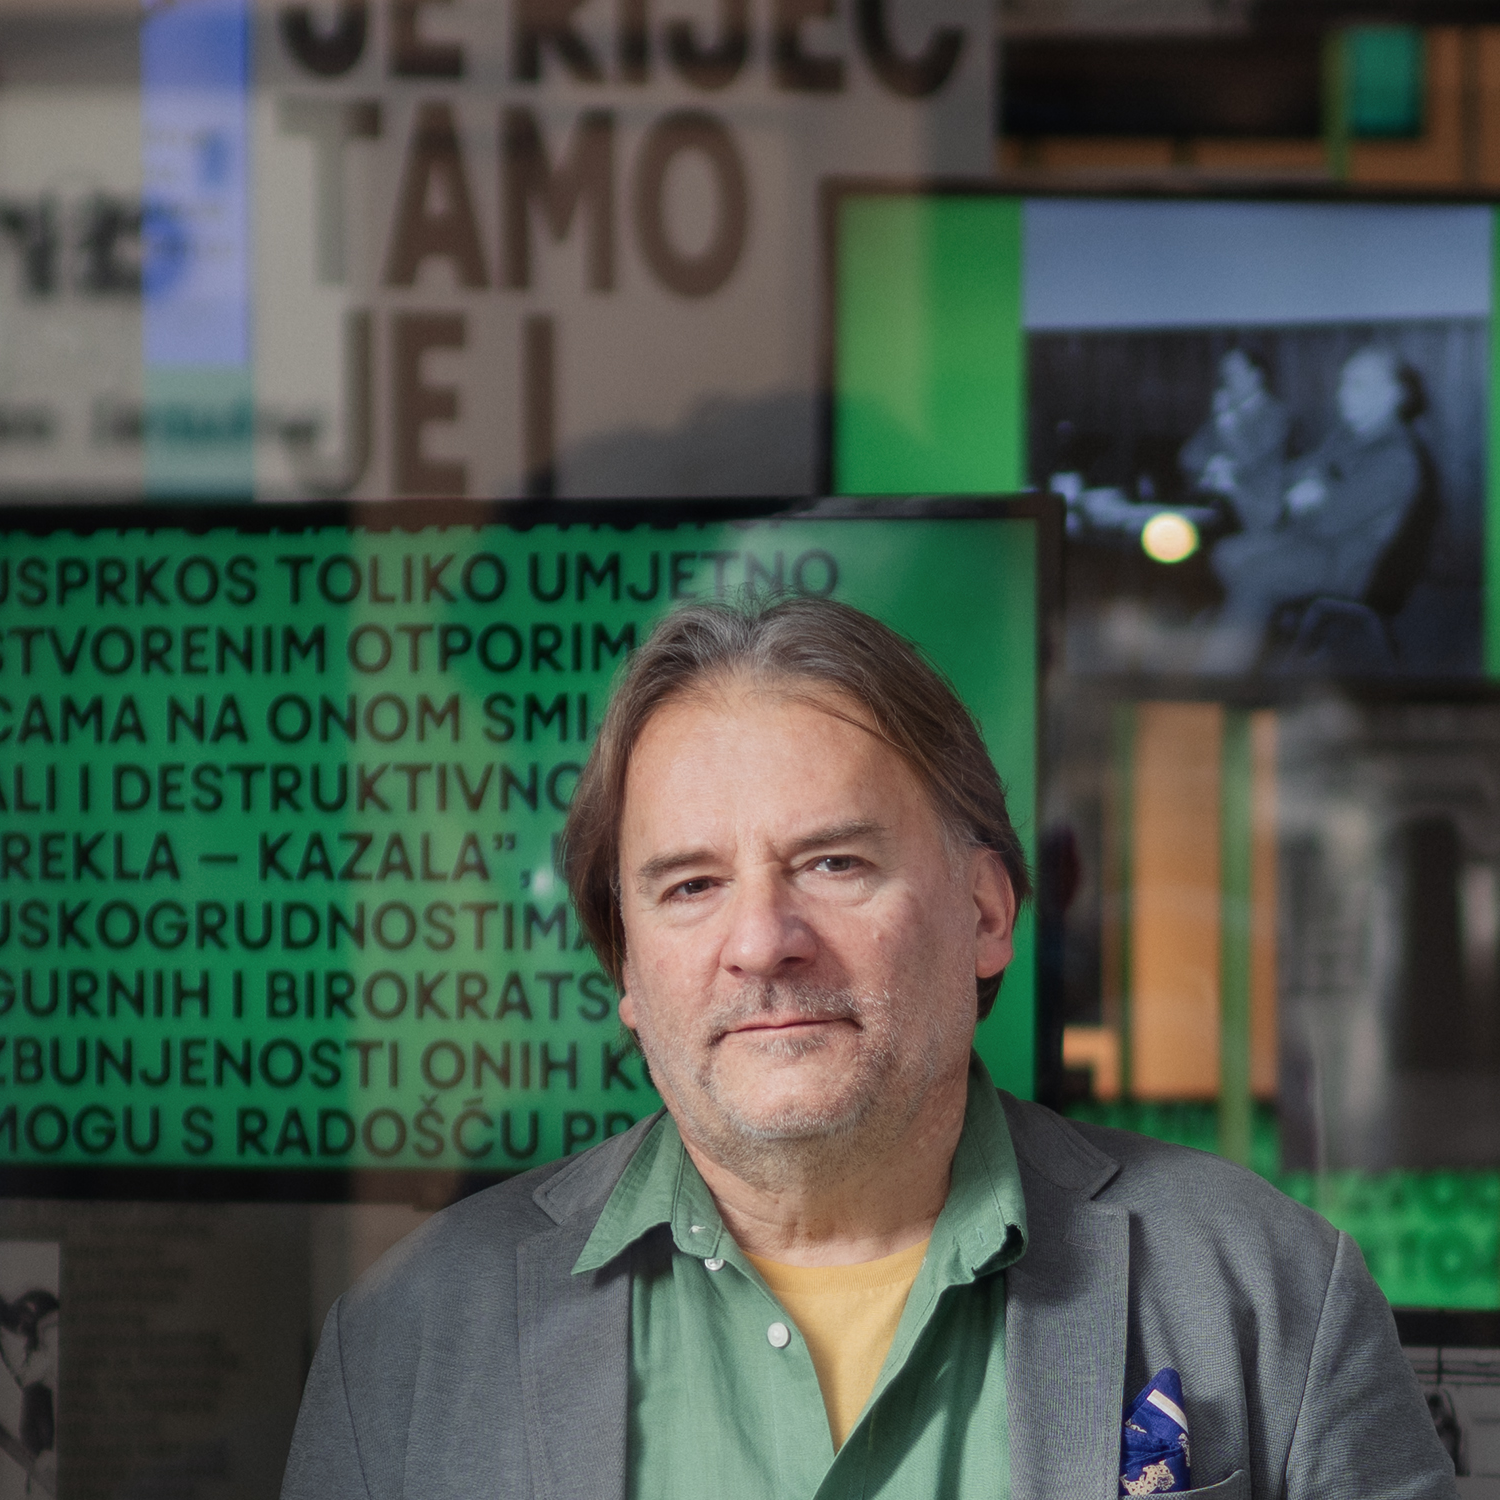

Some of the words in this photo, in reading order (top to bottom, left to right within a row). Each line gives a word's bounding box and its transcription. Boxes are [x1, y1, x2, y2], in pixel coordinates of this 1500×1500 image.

[273, 97, 749, 300] TAMO
[278, 553, 508, 607] TOLIKO
[528, 550, 839, 604] UMJETNO
[168, 694, 248, 743] NA
[268, 694, 460, 744] ONOM
[483, 692, 601, 743] SMI
[80, 764, 91, 813] I
[233, 971, 244, 1018] I
[267, 970, 612, 1021] BIROKRATS
[421, 1040, 578, 1090] ONIH
[184, 1107, 213, 1154] S
[238, 1096, 541, 1162] RADOŠĆU
